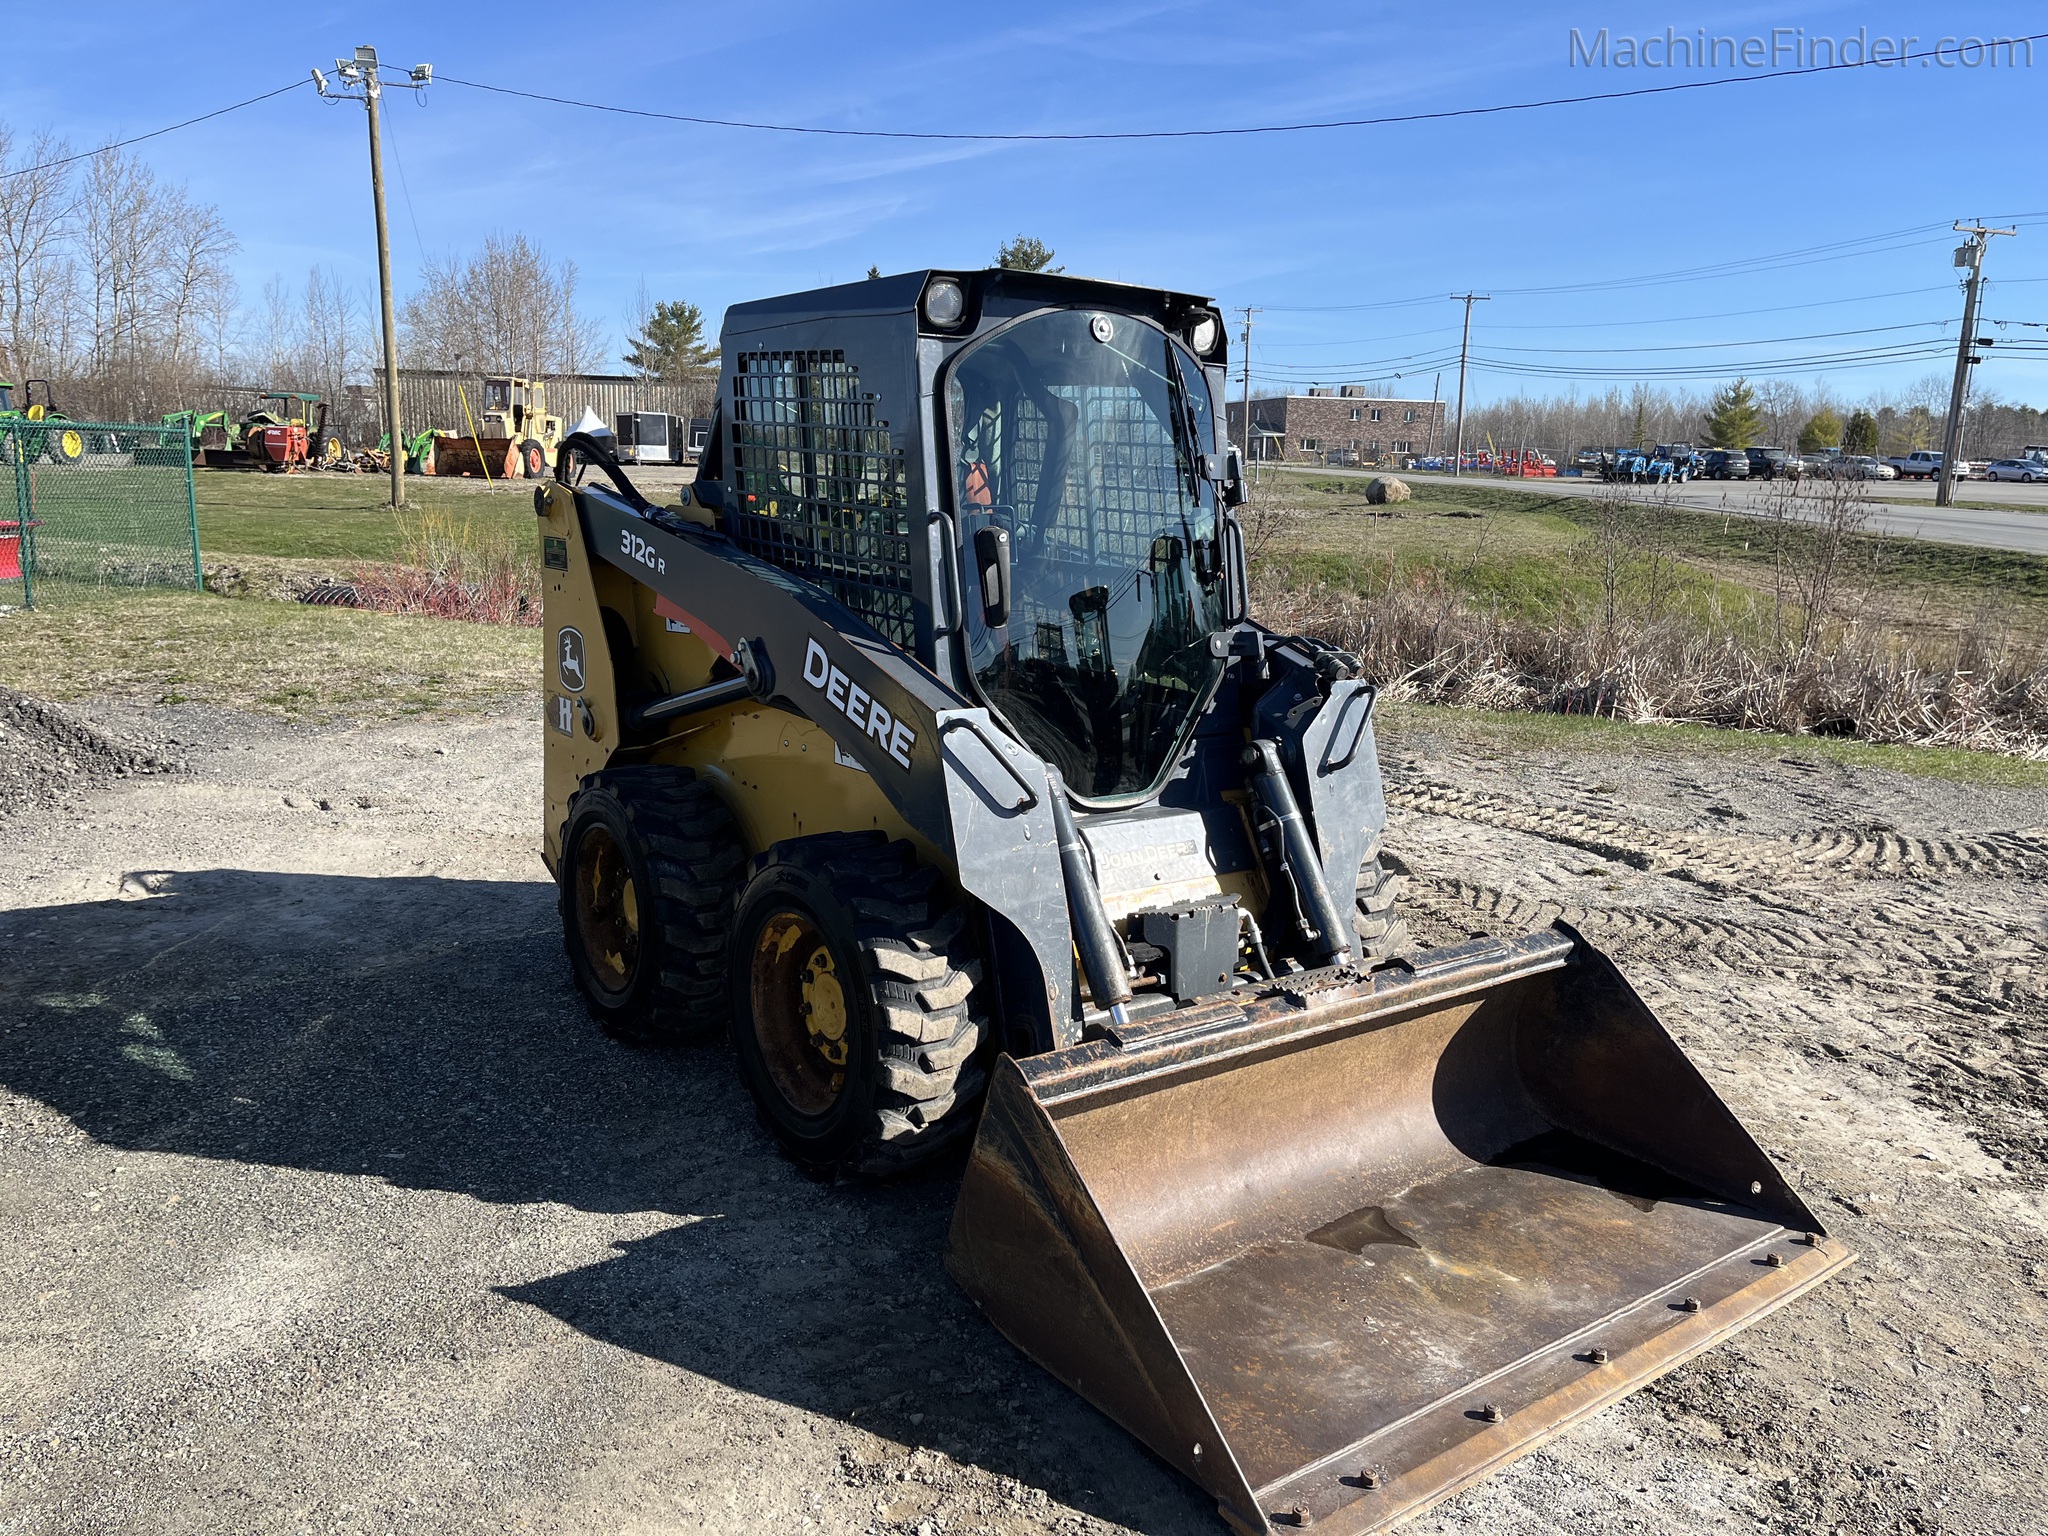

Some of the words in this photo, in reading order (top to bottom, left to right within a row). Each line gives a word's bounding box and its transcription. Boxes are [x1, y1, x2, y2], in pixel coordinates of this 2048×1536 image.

[621, 529, 655, 568] 312G
[658, 557, 665, 575] R
[803, 637, 915, 770] DEERE
[1102, 850, 1144, 870] JOHN
